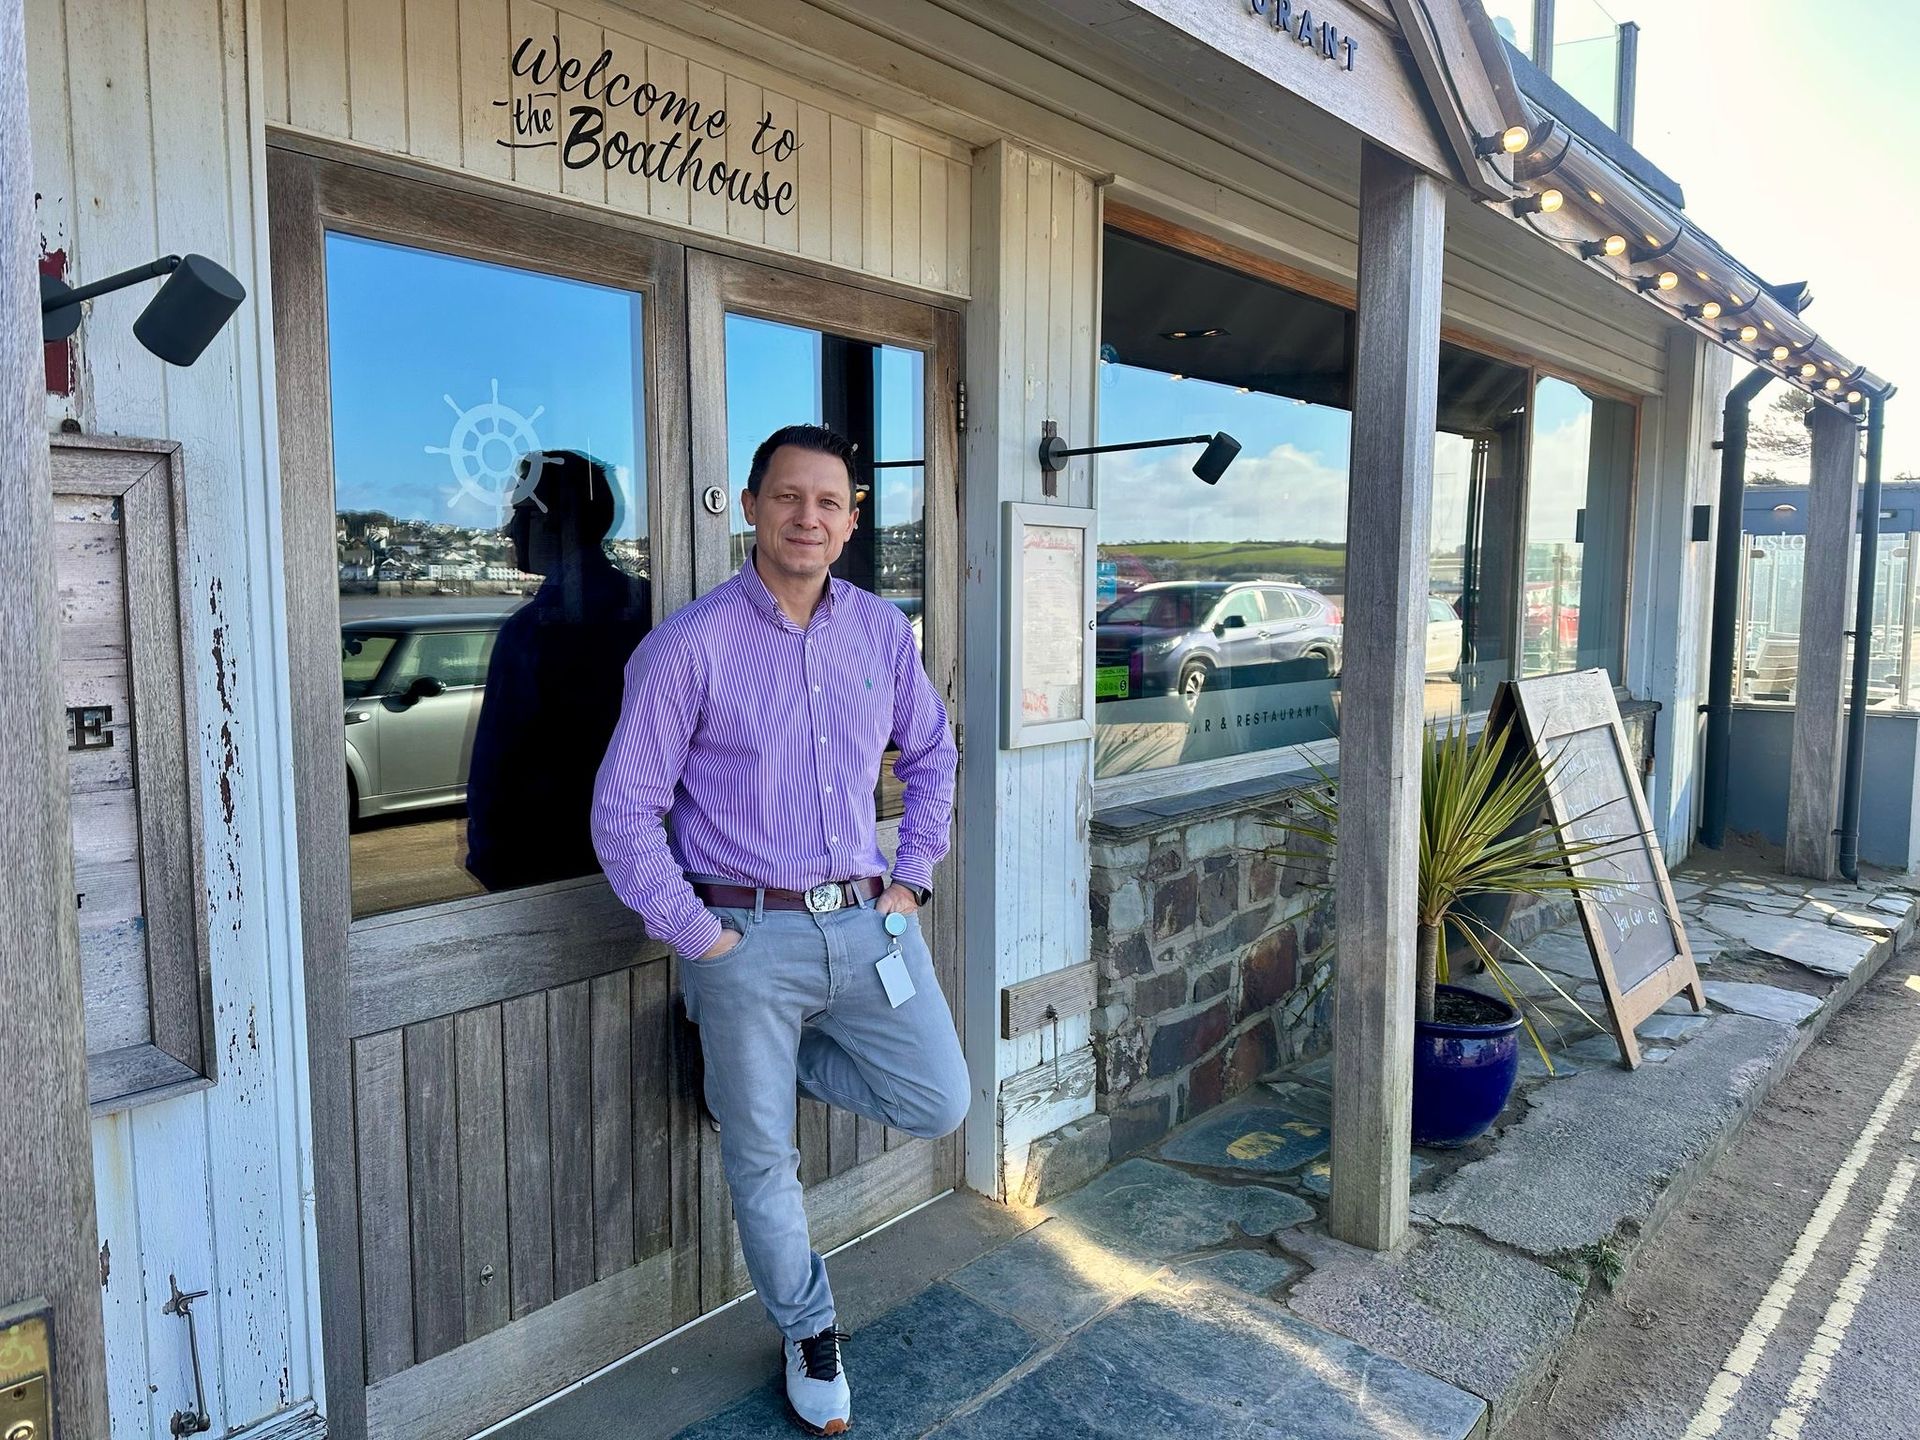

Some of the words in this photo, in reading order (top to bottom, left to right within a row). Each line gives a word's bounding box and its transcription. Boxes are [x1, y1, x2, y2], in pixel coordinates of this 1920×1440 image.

[511, 34, 731, 139] Welcome
[752, 111, 804, 162] to
[514, 93, 554, 137] the
[563, 105, 796, 216] Boathouse
[1221, 717, 1227, 729] &
[1237, 704, 1320, 727] RESTAURANT
